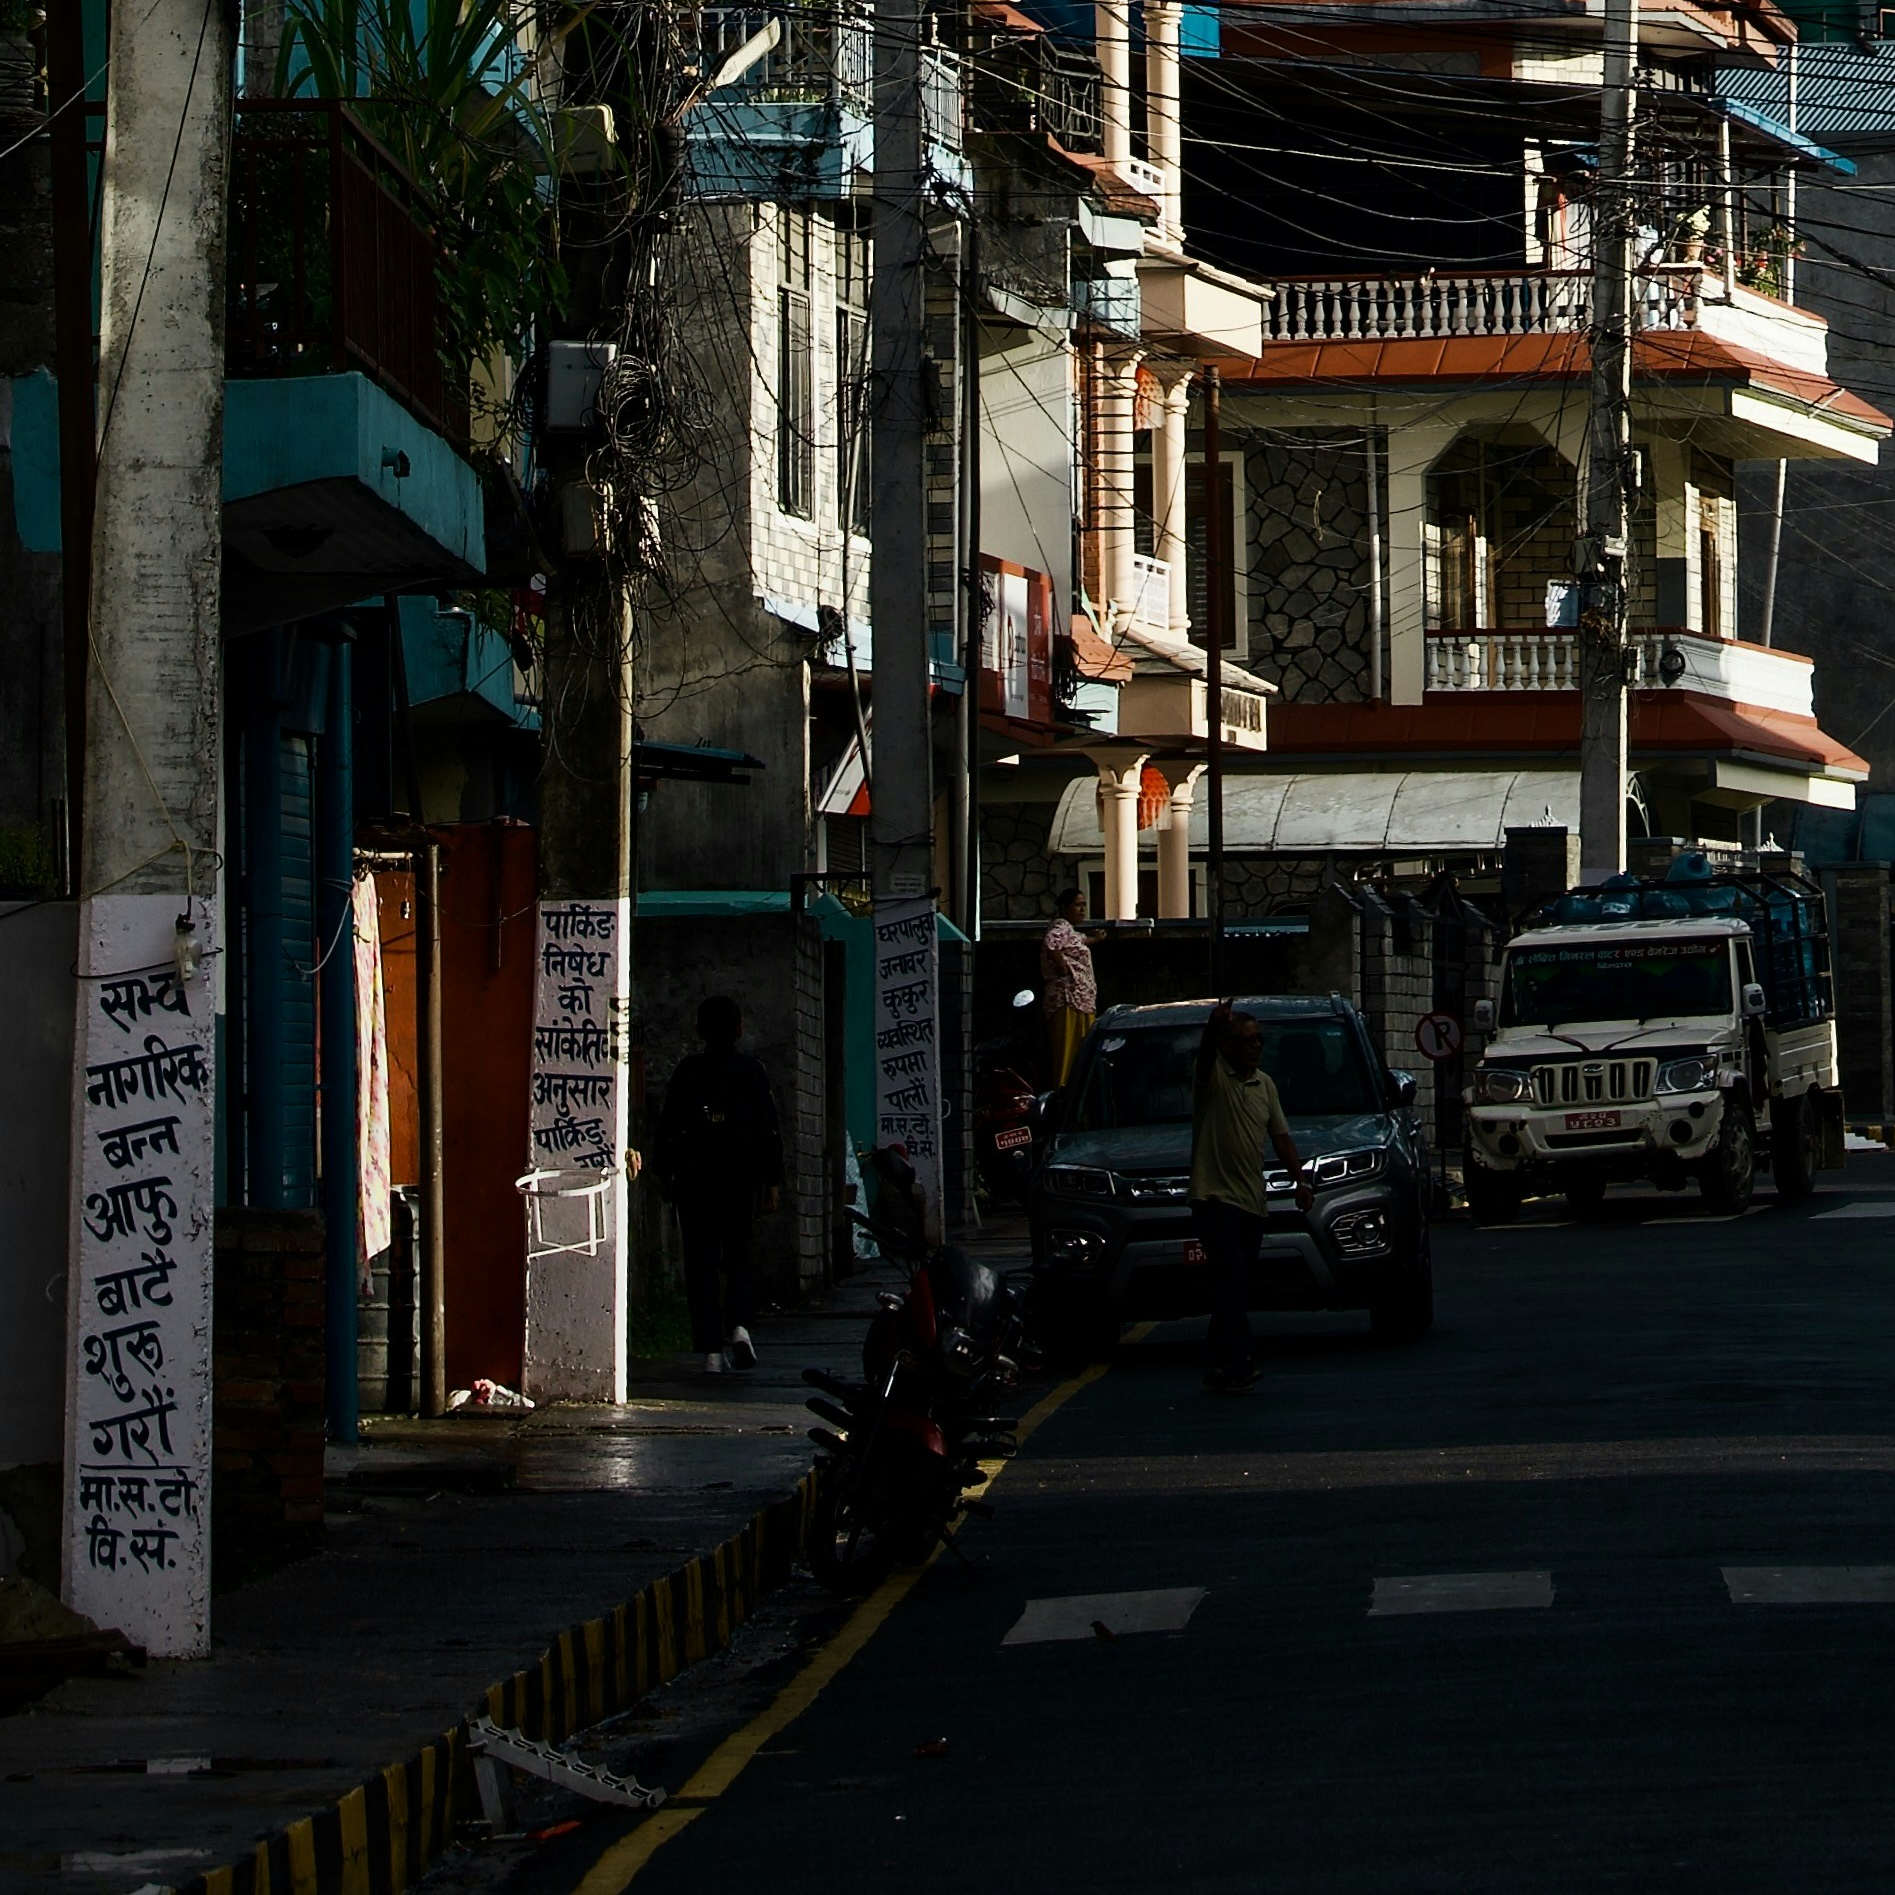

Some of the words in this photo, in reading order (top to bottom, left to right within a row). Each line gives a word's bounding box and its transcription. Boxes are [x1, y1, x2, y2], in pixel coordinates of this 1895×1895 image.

[542, 943, 611, 977] निषेध
[879, 949, 929, 979] जनावर
[558, 977, 594, 1014] को
[882, 980, 929, 1019] कुकुर
[86, 1035, 209, 1109] नागरिक
[533, 1072, 613, 1118] अनुसार
[98, 1115, 182, 1170] बन्न
[94, 1247, 177, 1315] बाटै
[89, 1384, 178, 1466] गरौं
